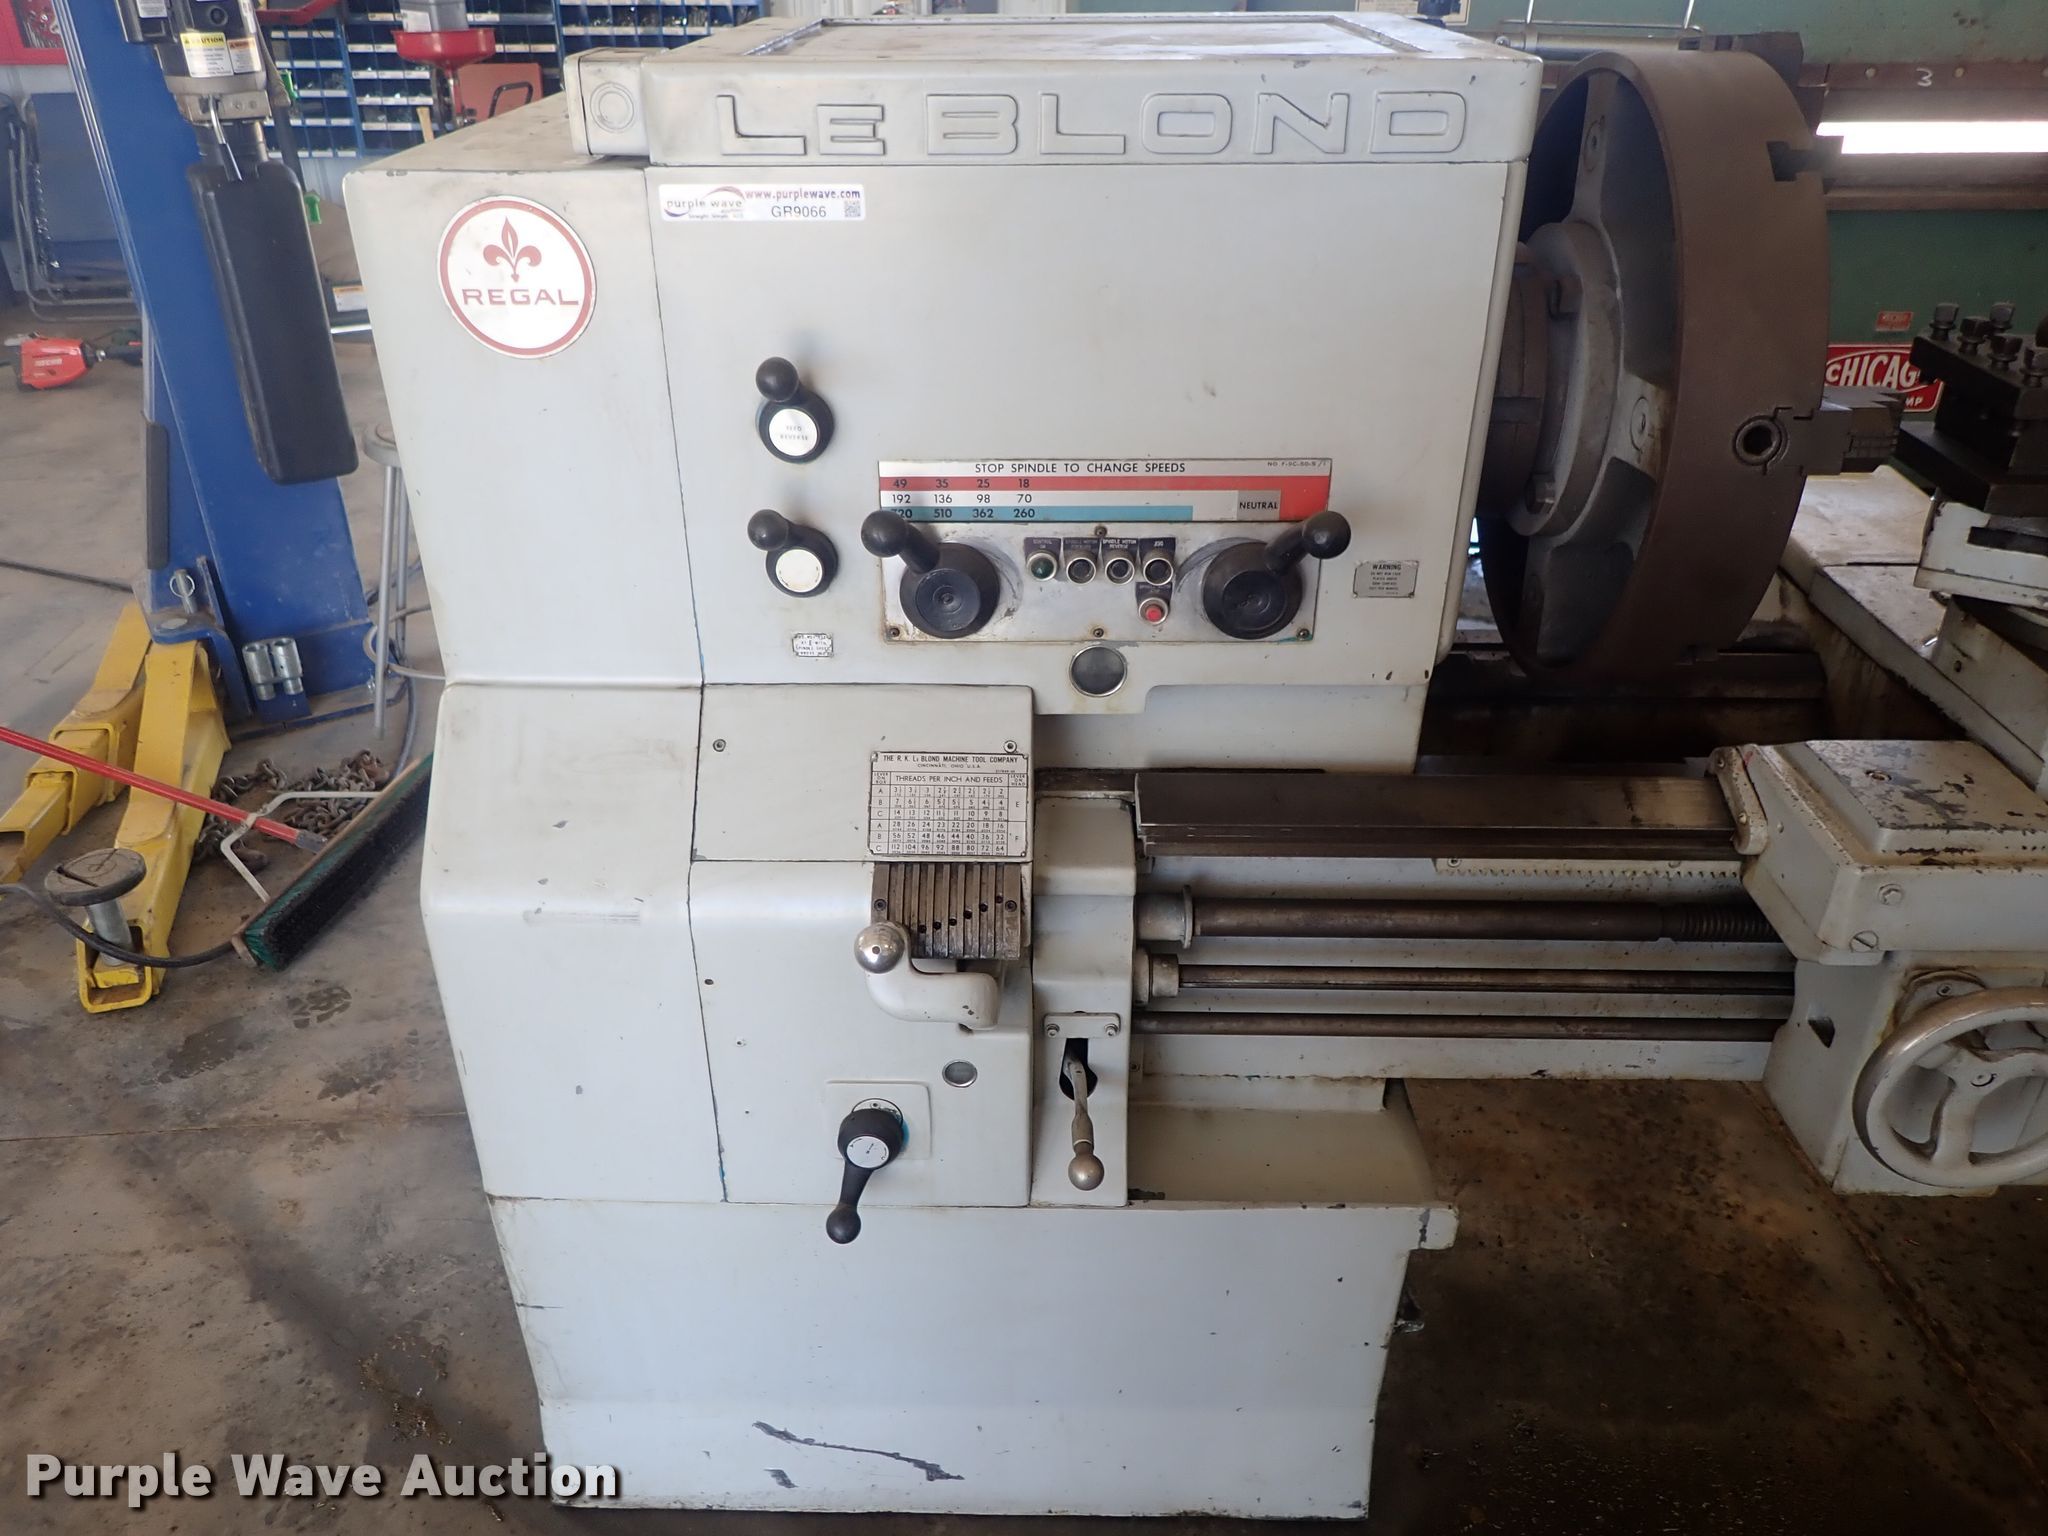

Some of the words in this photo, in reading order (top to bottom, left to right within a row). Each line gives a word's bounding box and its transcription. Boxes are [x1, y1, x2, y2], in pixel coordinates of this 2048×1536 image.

[1916, 68, 1933, 87] 3
[746, 188, 861, 201] www.purplewave.com
[711, 200, 743, 208] wave
[771, 205, 828, 218] GR9066
[462, 288, 579, 306] REGAL
[1825, 355, 1921, 389] CHICAG
[975, 464, 1004, 473] STOP
[1011, 464, 1057, 473] SPINDLE
[1064, 463, 1080, 473] TO
[1087, 463, 1138, 473] CHANGE
[1145, 462, 1186, 472] SPEEDS
[894, 479, 908, 488] 49
[935, 479, 949, 488] 35
[976, 479, 990, 488] 25
[1018, 479, 1030, 488] 18
[892, 494, 911, 504] 192
[934, 494, 953, 504] 136
[976, 494, 991, 504] 98
[1017, 494, 1032, 503] 70
[1239, 501, 1278, 510] NEUTRAL
[934, 508, 953, 518] 510
[972, 508, 994, 518] 362
[1014, 508, 1035, 518] 260
